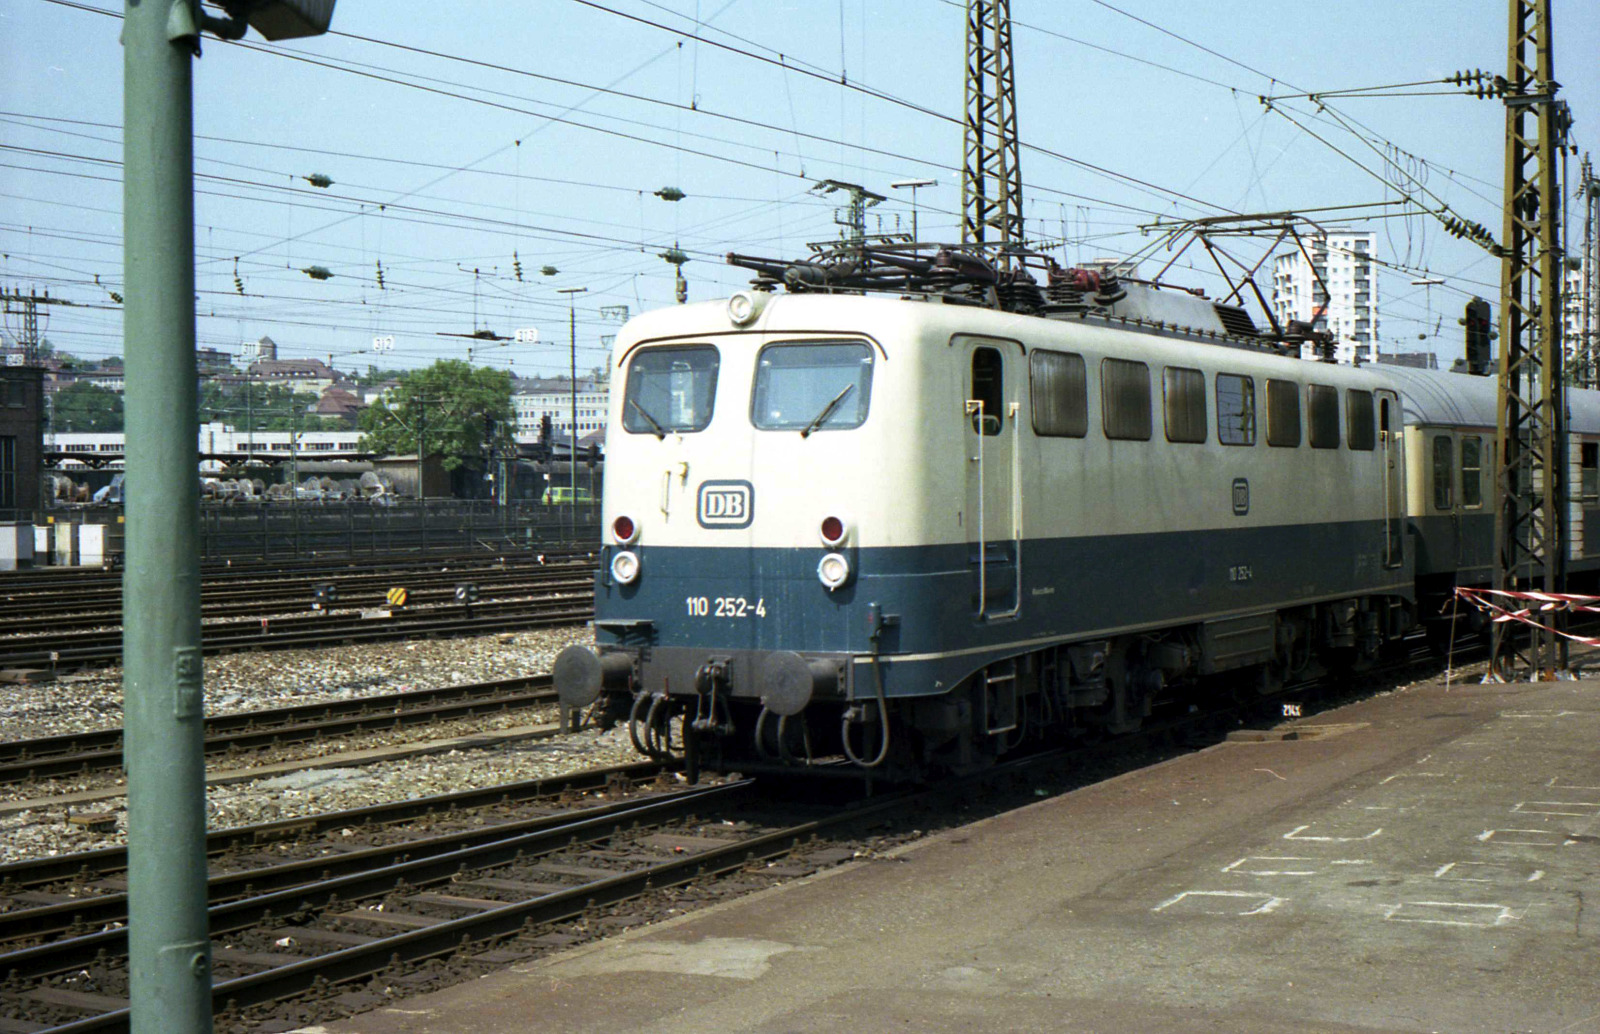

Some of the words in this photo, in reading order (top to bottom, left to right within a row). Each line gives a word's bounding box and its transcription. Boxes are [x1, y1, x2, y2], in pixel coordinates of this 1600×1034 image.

[374, 338, 393, 350] 312
[518, 330, 536, 342] 313
[706, 492, 743, 517] DB
[686, 597, 709, 616] 110
[715, 598, 766, 618] 252-4
